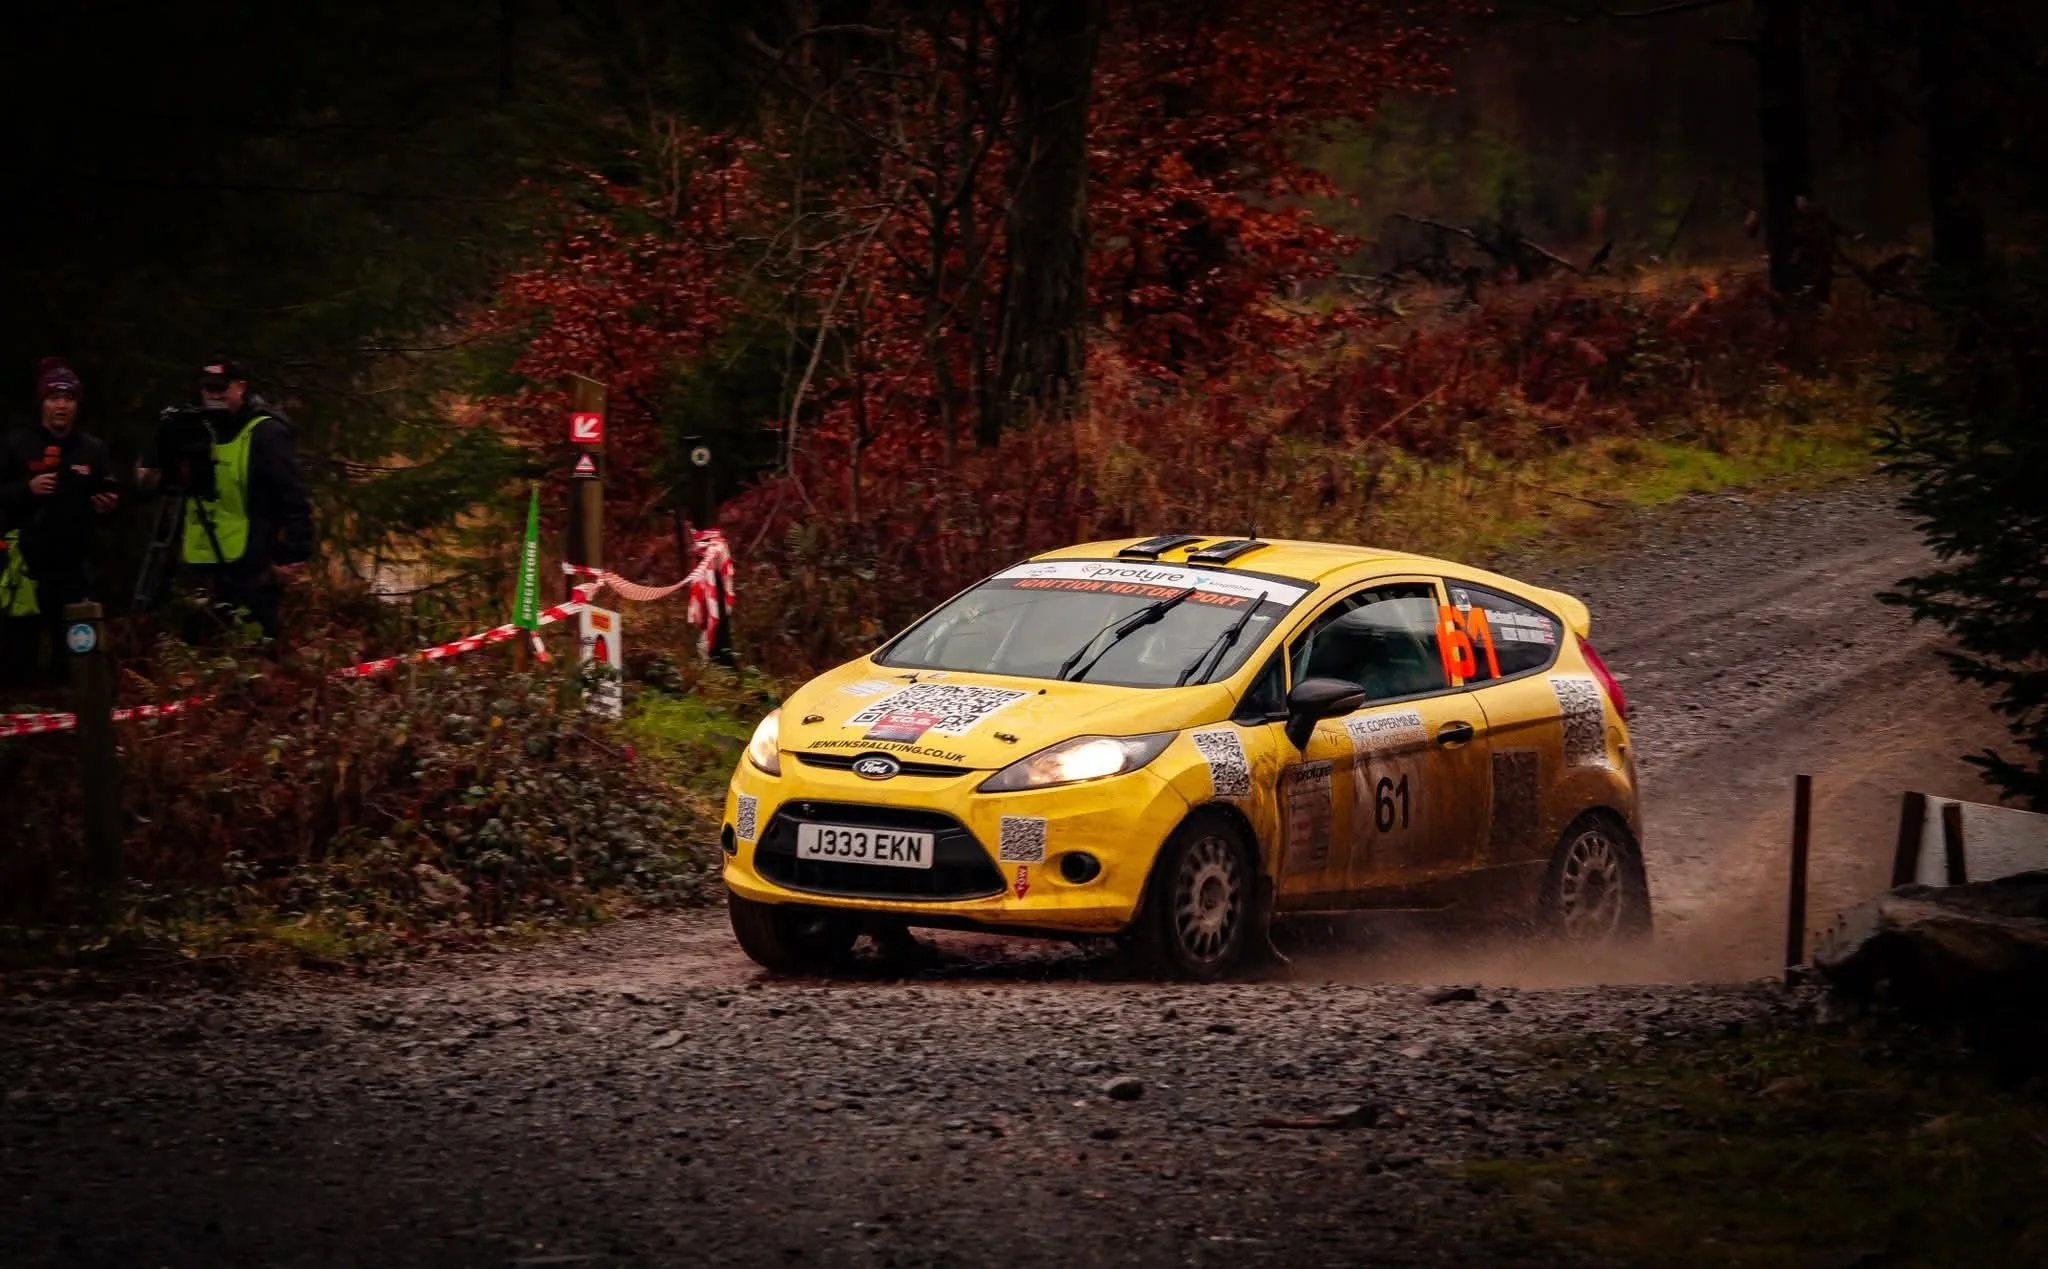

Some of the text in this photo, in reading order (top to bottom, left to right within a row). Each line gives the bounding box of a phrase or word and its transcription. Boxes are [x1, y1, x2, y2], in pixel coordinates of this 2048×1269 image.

[1089, 567, 1185, 582] protyre
[1014, 579, 1248, 606] IGNITION MOTORPORT
[1436, 606, 1501, 687] 61
[1348, 721, 1366, 736] THE
[807, 740, 967, 762] JENKINSRALLYING.CO.UK
[859, 761, 889, 774] Ford
[1375, 774, 1409, 832] 61
[808, 829, 923, 862] J333 EKN
